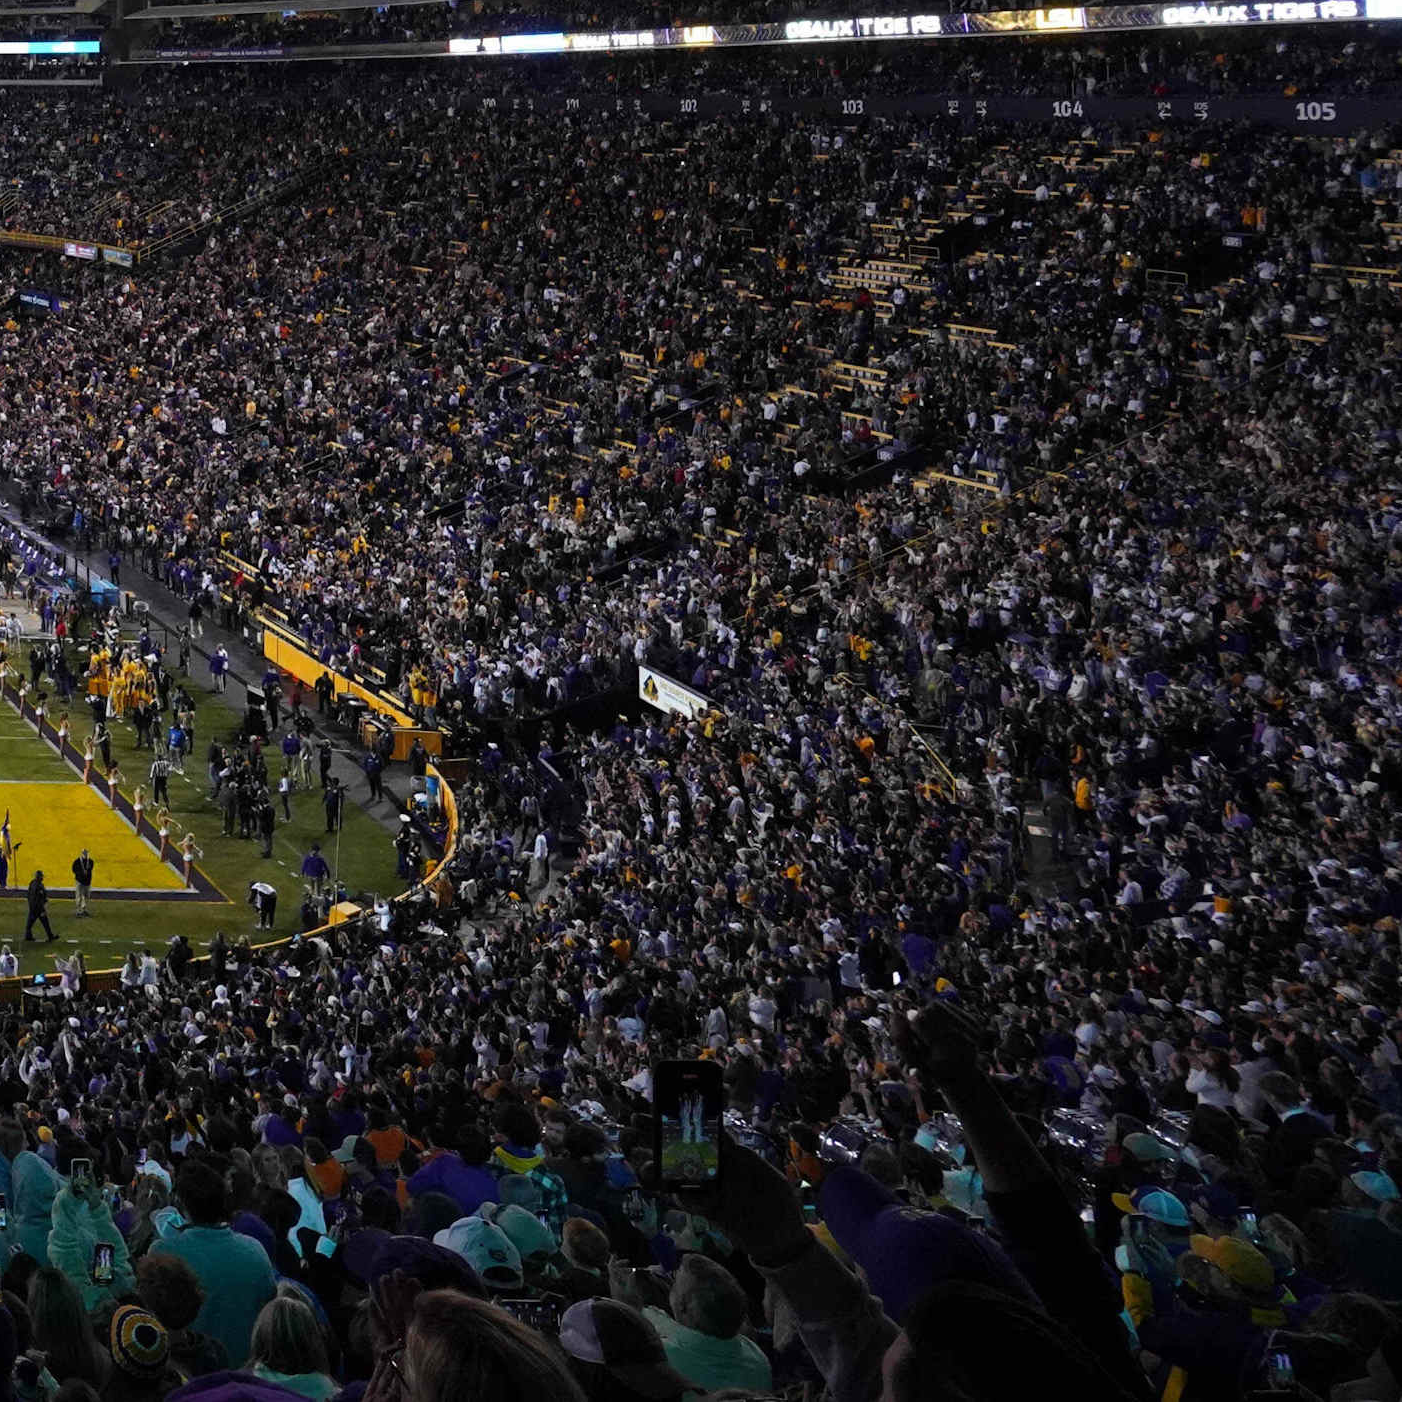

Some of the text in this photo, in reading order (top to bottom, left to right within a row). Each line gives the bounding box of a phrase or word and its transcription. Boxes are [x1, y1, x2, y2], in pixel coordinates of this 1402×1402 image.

[1035, 7, 1083, 29] LSU
[1162, 4, 1249, 25] GEAUX
[785, 19, 853, 39] GEAUX
[842, 100, 864, 115] 103
[1052, 101, 1083, 118] 104
[1295, 101, 1336, 122] 105
